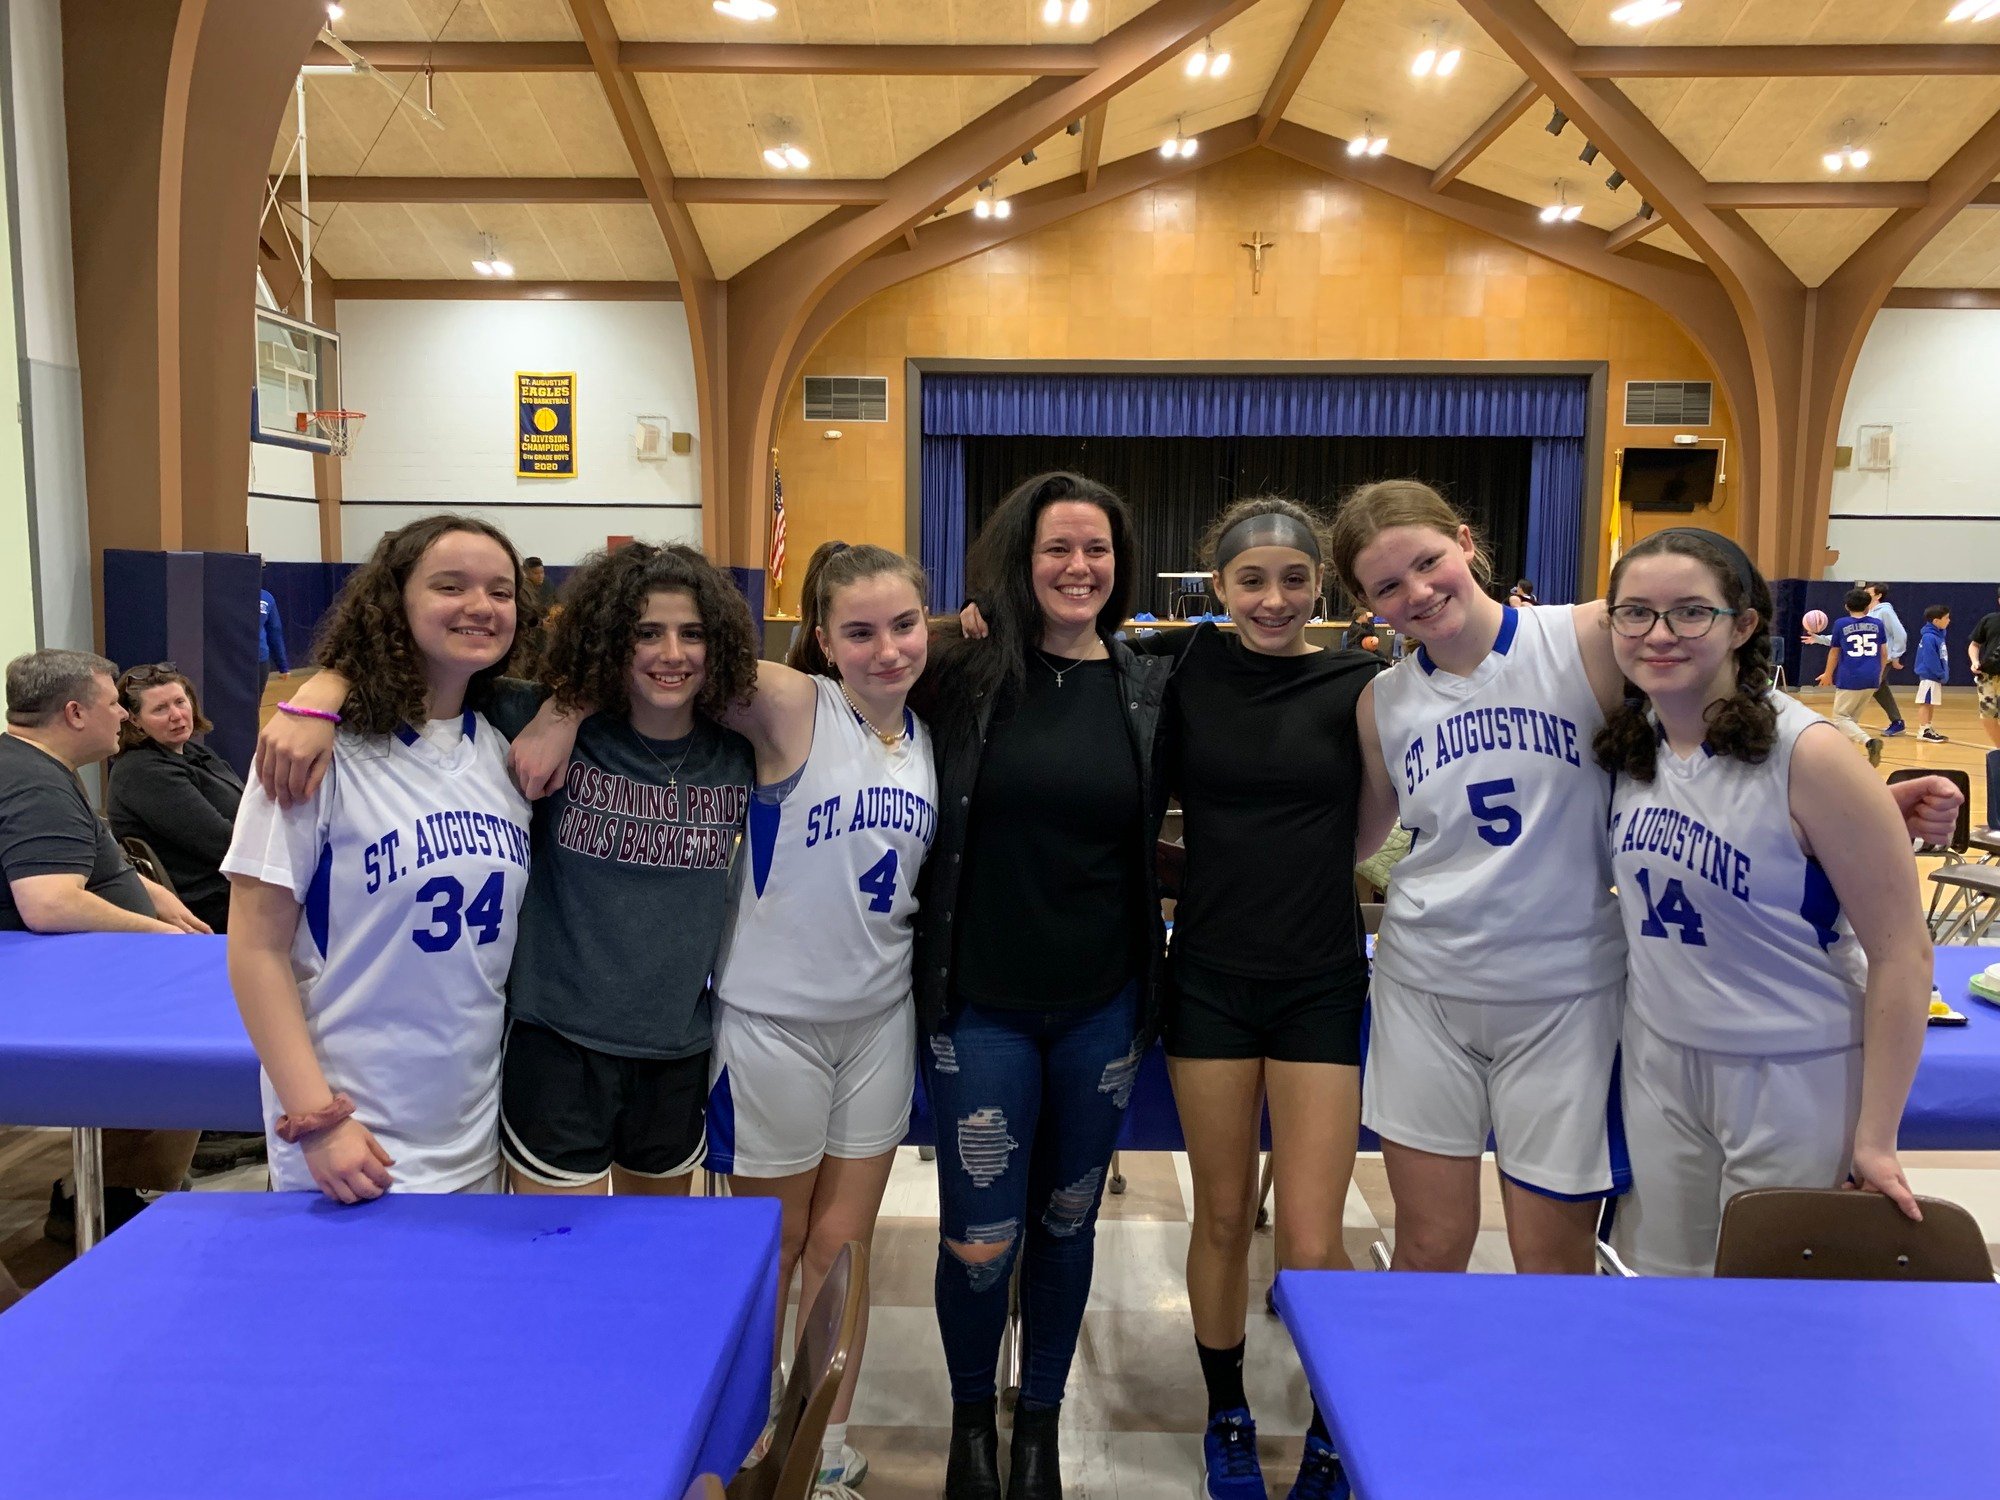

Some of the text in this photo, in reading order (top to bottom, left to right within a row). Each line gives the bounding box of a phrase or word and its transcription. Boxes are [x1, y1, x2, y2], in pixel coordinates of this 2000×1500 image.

[522, 387, 569, 397] EAGLES
[522, 443, 569, 452] CHAMPIONS
[524, 434, 567, 443] C DIVISION
[534, 462, 558, 471] 2020
[1846, 633, 1878, 657] 35
[1405, 707, 1581, 796] ST. AUGUSTINE
[567, 761, 748, 824] OSSINING PRIDE
[806, 787, 939, 848] ST. AUGUSTIN
[1466, 777, 1522, 847] 5
[364, 829, 407, 895] ST.
[558, 805, 619, 860] GIRLS
[1621, 807, 1751, 903] AUGUSTINE
[412, 871, 505, 953] 34
[858, 848, 898, 913] 4
[1634, 867, 1708, 947] 14
